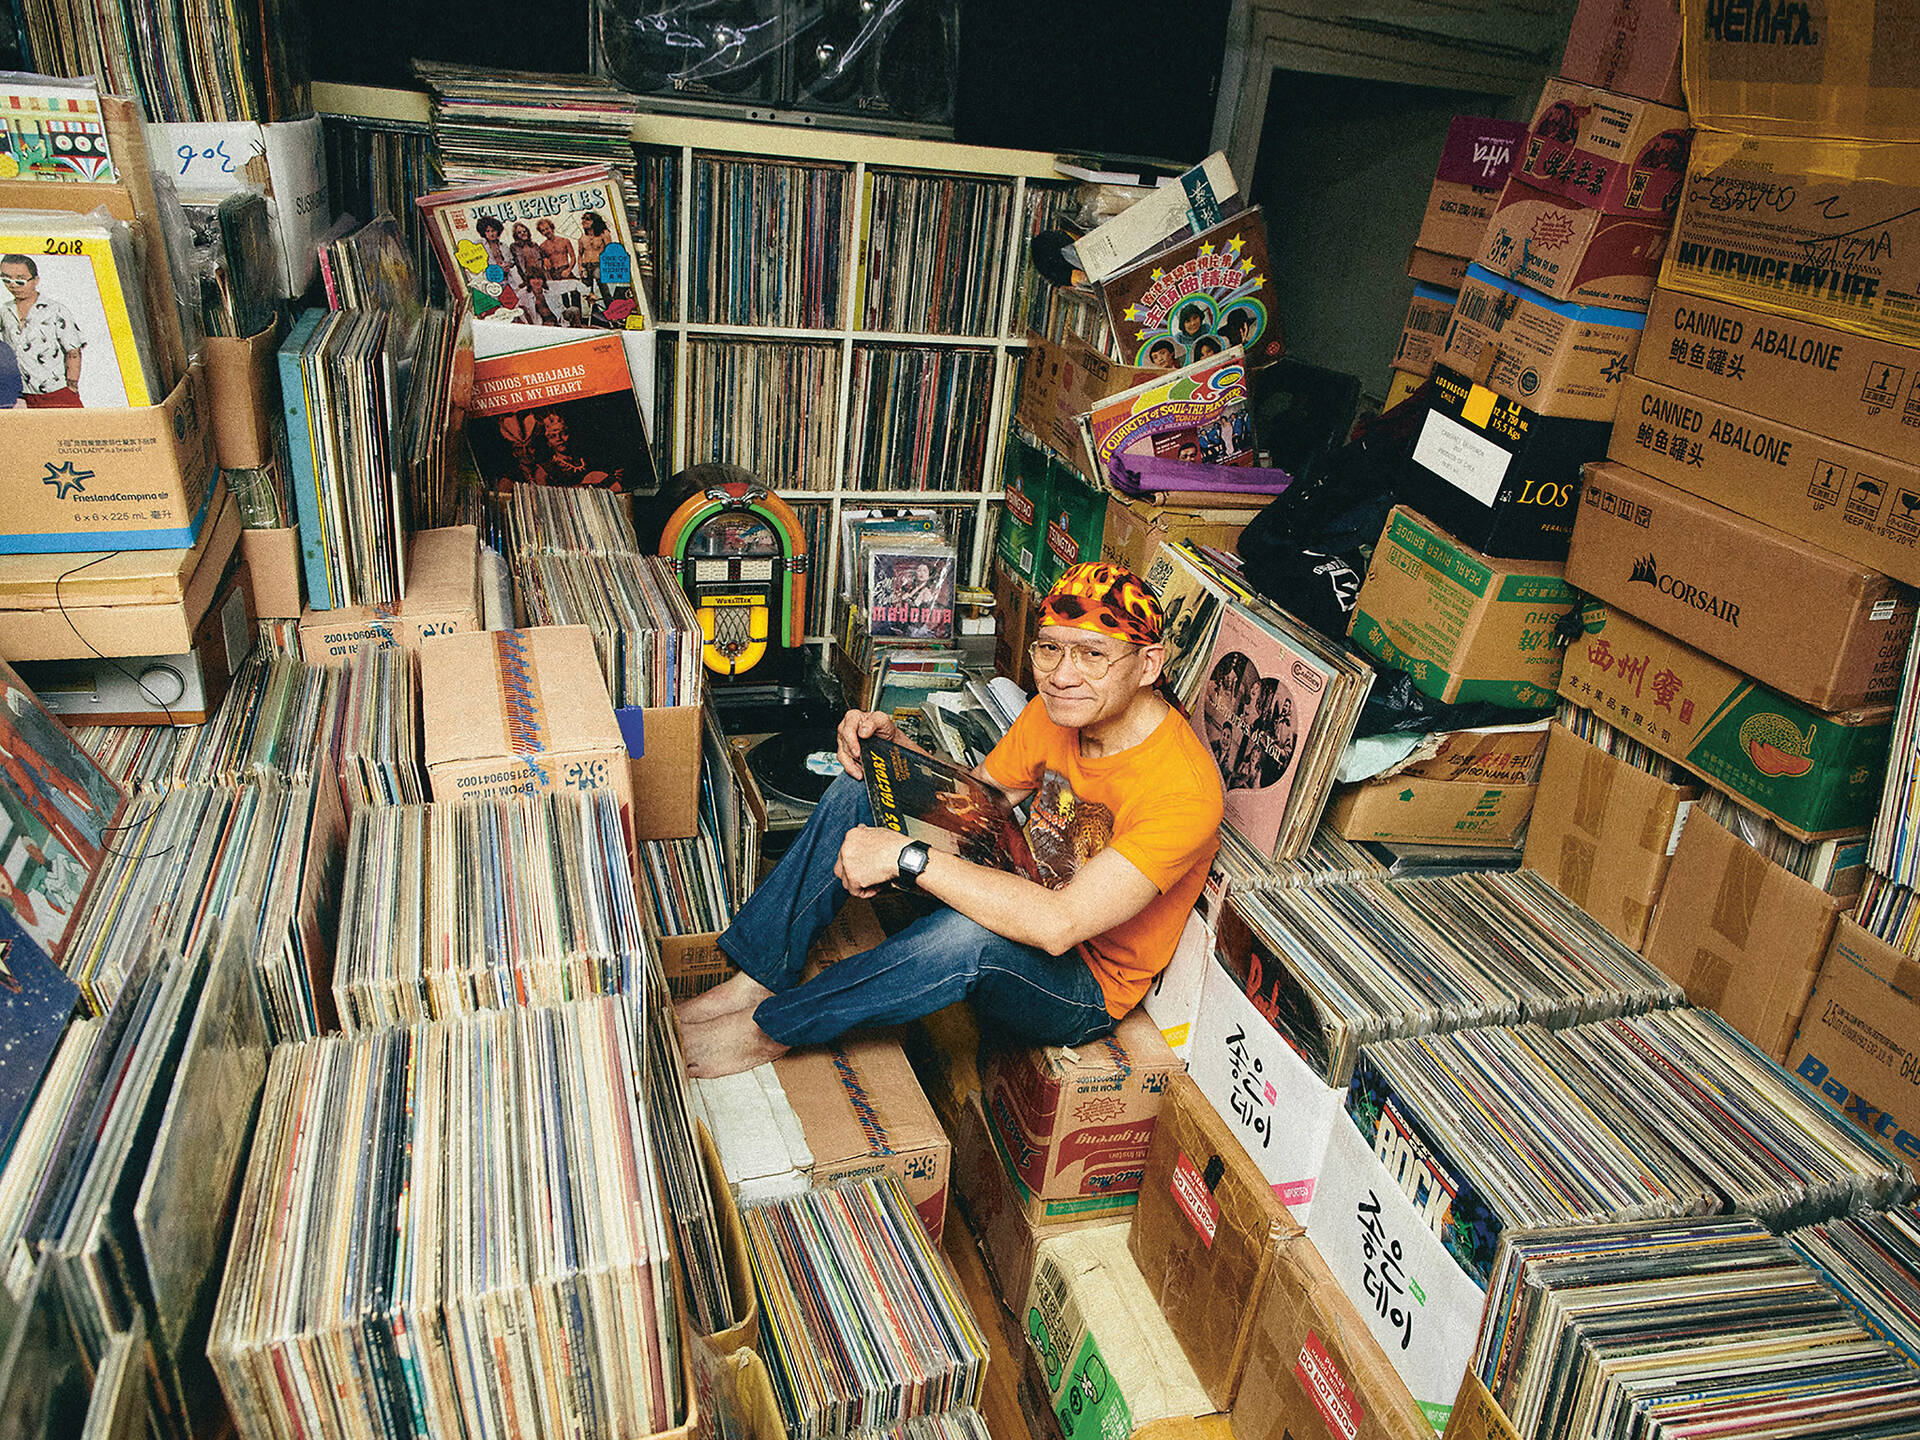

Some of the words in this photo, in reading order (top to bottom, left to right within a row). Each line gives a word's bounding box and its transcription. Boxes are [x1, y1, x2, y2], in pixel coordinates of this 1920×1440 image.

[1473, 143, 1510, 177] vita
[518, 188, 607, 219] EAGLES
[43, 238, 84, 255] 2018
[1678, 240, 1713, 272] MY
[1710, 250, 1789, 289] DEVICE
[1789, 263, 1830, 297] MY
[1828, 266, 1880, 309] LIFE
[1675, 307, 1743, 344] CANNED
[1750, 327, 1843, 371] ABALONE
[1668, 336, 1747, 381] 鲍鱼罐头
[483, 377, 522, 394] INDIOS
[522, 364, 586, 386] TABAJARAS
[511, 391, 523, 404] IN
[526, 386, 544, 402] MY
[545, 380, 583, 397] HEART
[1440, 391, 1455, 405] CHILE
[1868, 407, 1881, 416] UP
[1106, 411, 1150, 448] QUARTET
[1507, 425, 1521, 441] Kgs
[1641, 394, 1703, 433] CANNED
[1709, 419, 1793, 467] ABALONE
[1636, 421, 1705, 469] 鲍鱼罐头
[73, 493, 157, 503] FrieslandCampina
[1007, 490, 1031, 518] TSINGTAO
[1517, 480, 1574, 508] LOS
[1813, 502, 1825, 512] UP
[74, 513, 81, 522] 6
[92, 513, 100, 521] 6
[110, 512, 129, 521] 225
[132, 512, 148, 520] mL
[1842, 513, 1865, 528] KEEP
[1050, 526, 1076, 560] TSINGTAO
[1396, 523, 1427, 550] BRIDGE
[1427, 544, 1453, 568] RIVER
[1455, 564, 1482, 586] PEARL
[872, 603, 952, 623] madonna
[1658, 575, 1741, 628] CORSAIR
[330, 647, 346, 656] MD
[1251, 728, 1265, 744] of
[1264, 735, 1284, 762] You
[457, 769, 537, 788] 231509041002
[870, 750, 896, 809] FACTORY
[1077, 1085, 1090, 1093] MD
[1795, 1053, 1920, 1163] Baxte
[1075, 1130, 1131, 1146] goreng
[1174, 1171, 1184, 1188] DO
[1183, 1186, 1197, 1207] NOT
[1375, 1111, 1453, 1242] ROCK
[1311, 1349, 1330, 1376] HANDLE
[1329, 1377, 1341, 1396] WITH
[1324, 1356, 1346, 1392] PLEASE
[1301, 1352, 1313, 1372] DO
[1313, 1372, 1331, 1399] NOT
[1331, 1399, 1354, 1436] DROP
